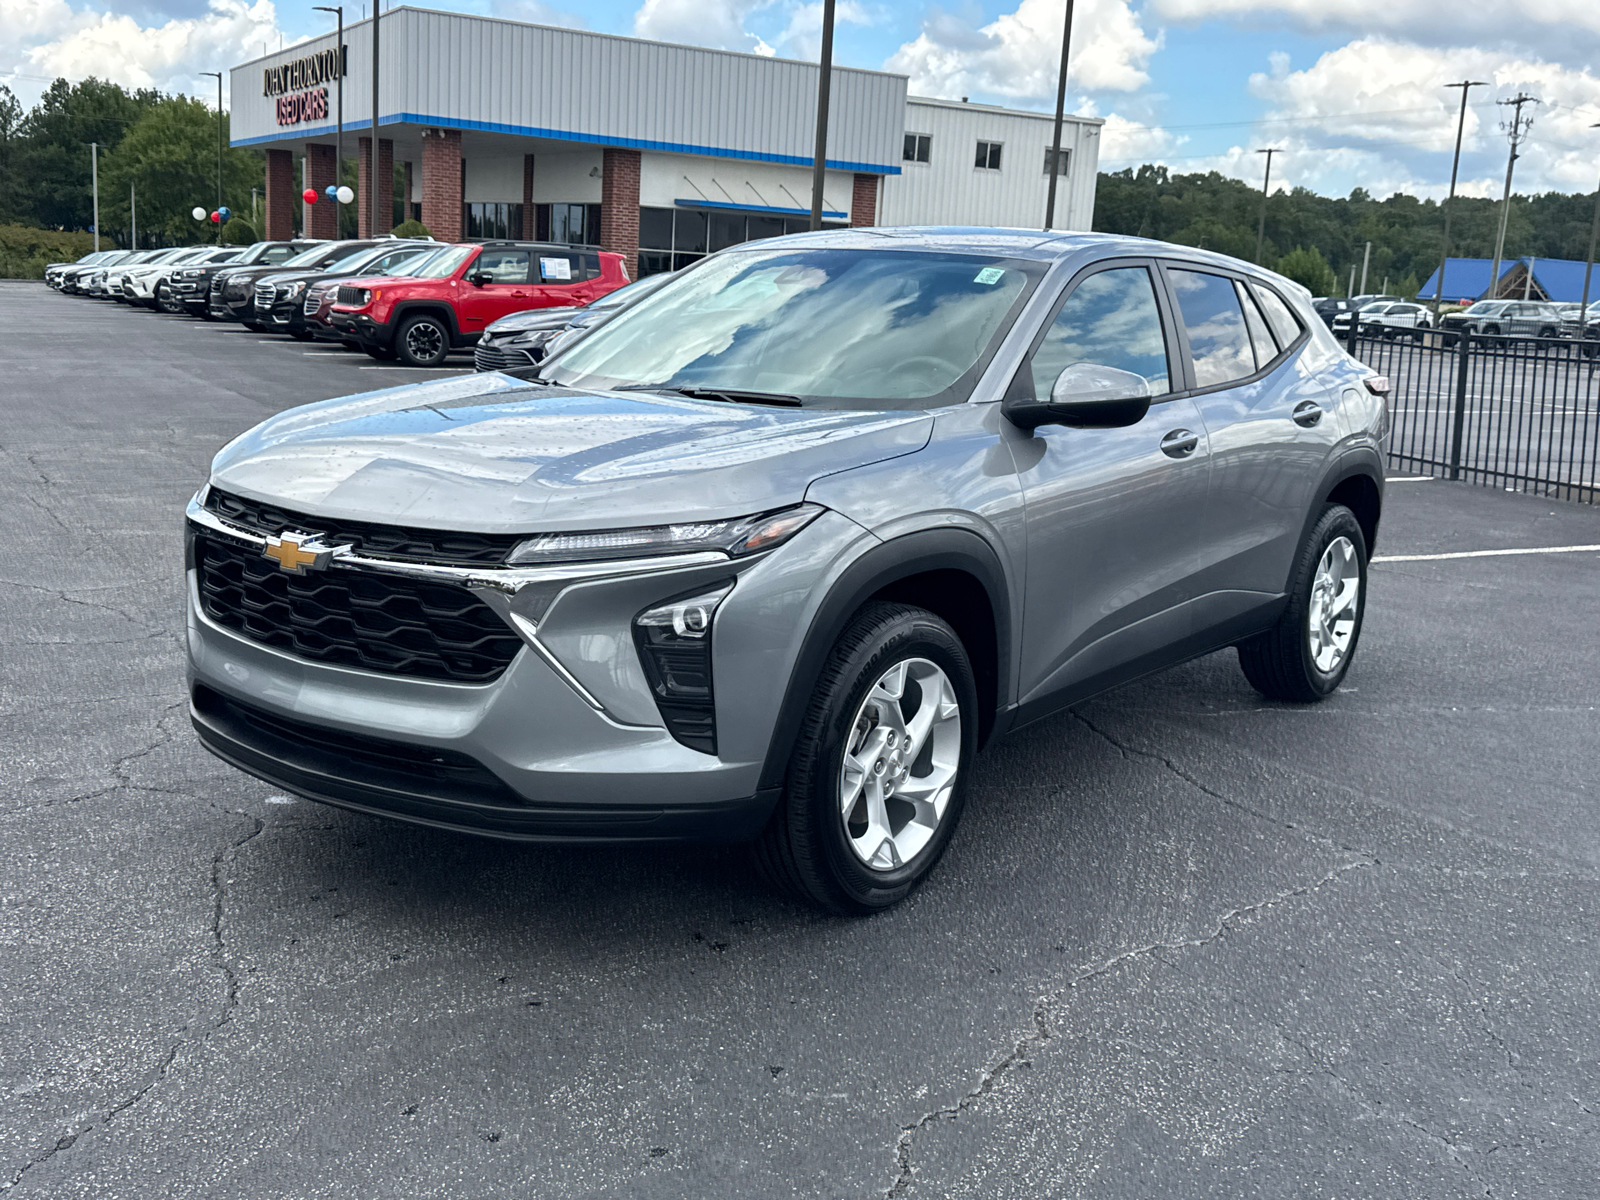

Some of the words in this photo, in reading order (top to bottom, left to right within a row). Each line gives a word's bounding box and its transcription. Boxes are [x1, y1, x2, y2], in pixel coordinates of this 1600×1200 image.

[263, 65, 287, 97] JOHN
[275, 94, 300, 126] USED
[300, 87, 329, 122] CARS
